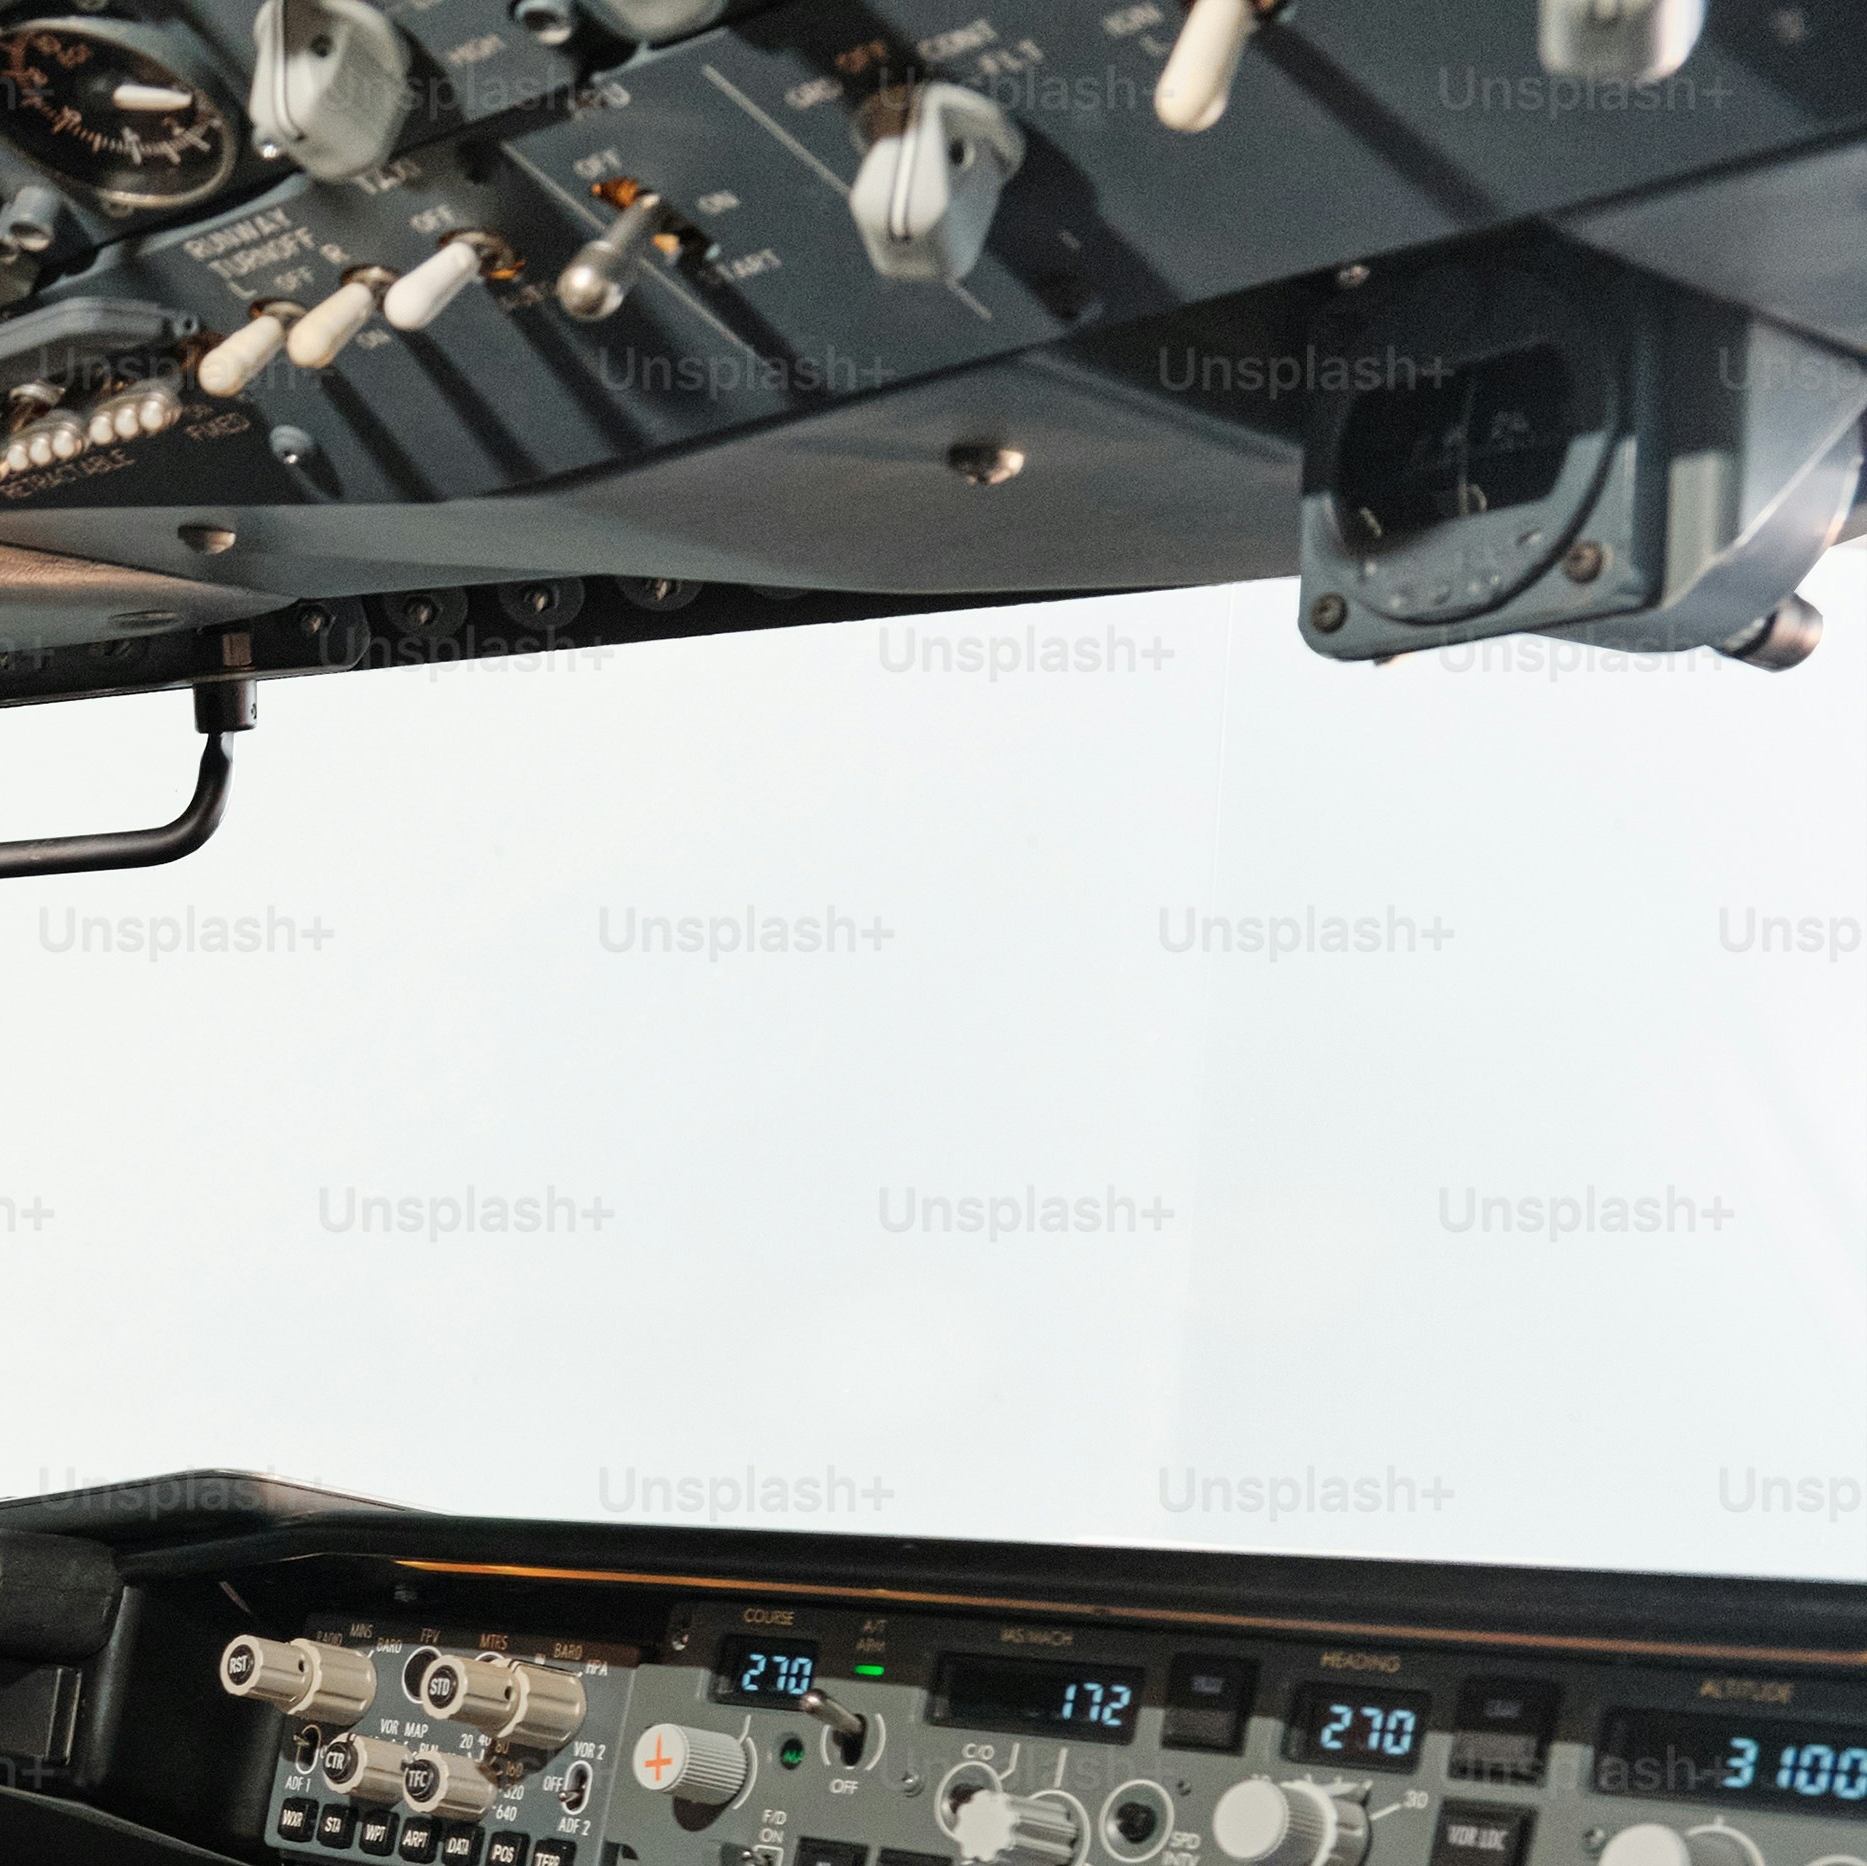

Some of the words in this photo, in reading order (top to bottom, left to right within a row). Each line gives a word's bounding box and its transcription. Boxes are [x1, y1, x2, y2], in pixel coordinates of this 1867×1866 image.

[183, 205, 291, 262] RUNWAY
[207, 226, 317, 281] TURNOFF
[743, 1607, 795, 1626] COURSE
[229, 1654, 249, 1675] RST
[742, 1653, 813, 1695] 270
[428, 1676, 451, 1698] STD
[1062, 1682, 1131, 1726] 172
[380, 1719, 399, 1735] VOR
[404, 1722, 429, 1739] MAP
[1320, 1704, 1416, 1755] 270
[325, 1746, 345, 1770] CTR
[573, 1741, 595, 1759] VOR
[596, 1744, 605, 1760] 2
[285, 1775, 304, 1791] ADF
[408, 1768, 428, 1787] TFC
[543, 1776, 563, 1792] OFF
[829, 1779, 859, 1795] OFF
[282, 1808, 304, 1827] WXR
[496, 1805, 518, 1822] 640
[324, 1816, 341, 1833] STA
[365, 1823, 385, 1843] WPT
[558, 1816, 579, 1834] ADF
[581, 1819, 591, 1836] 2
[402, 1828, 427, 1848] ARPT
[447, 1835, 469, 1855] DATA
[760, 1828, 784, 1843] ON
[492, 1844, 515, 1863] POS
